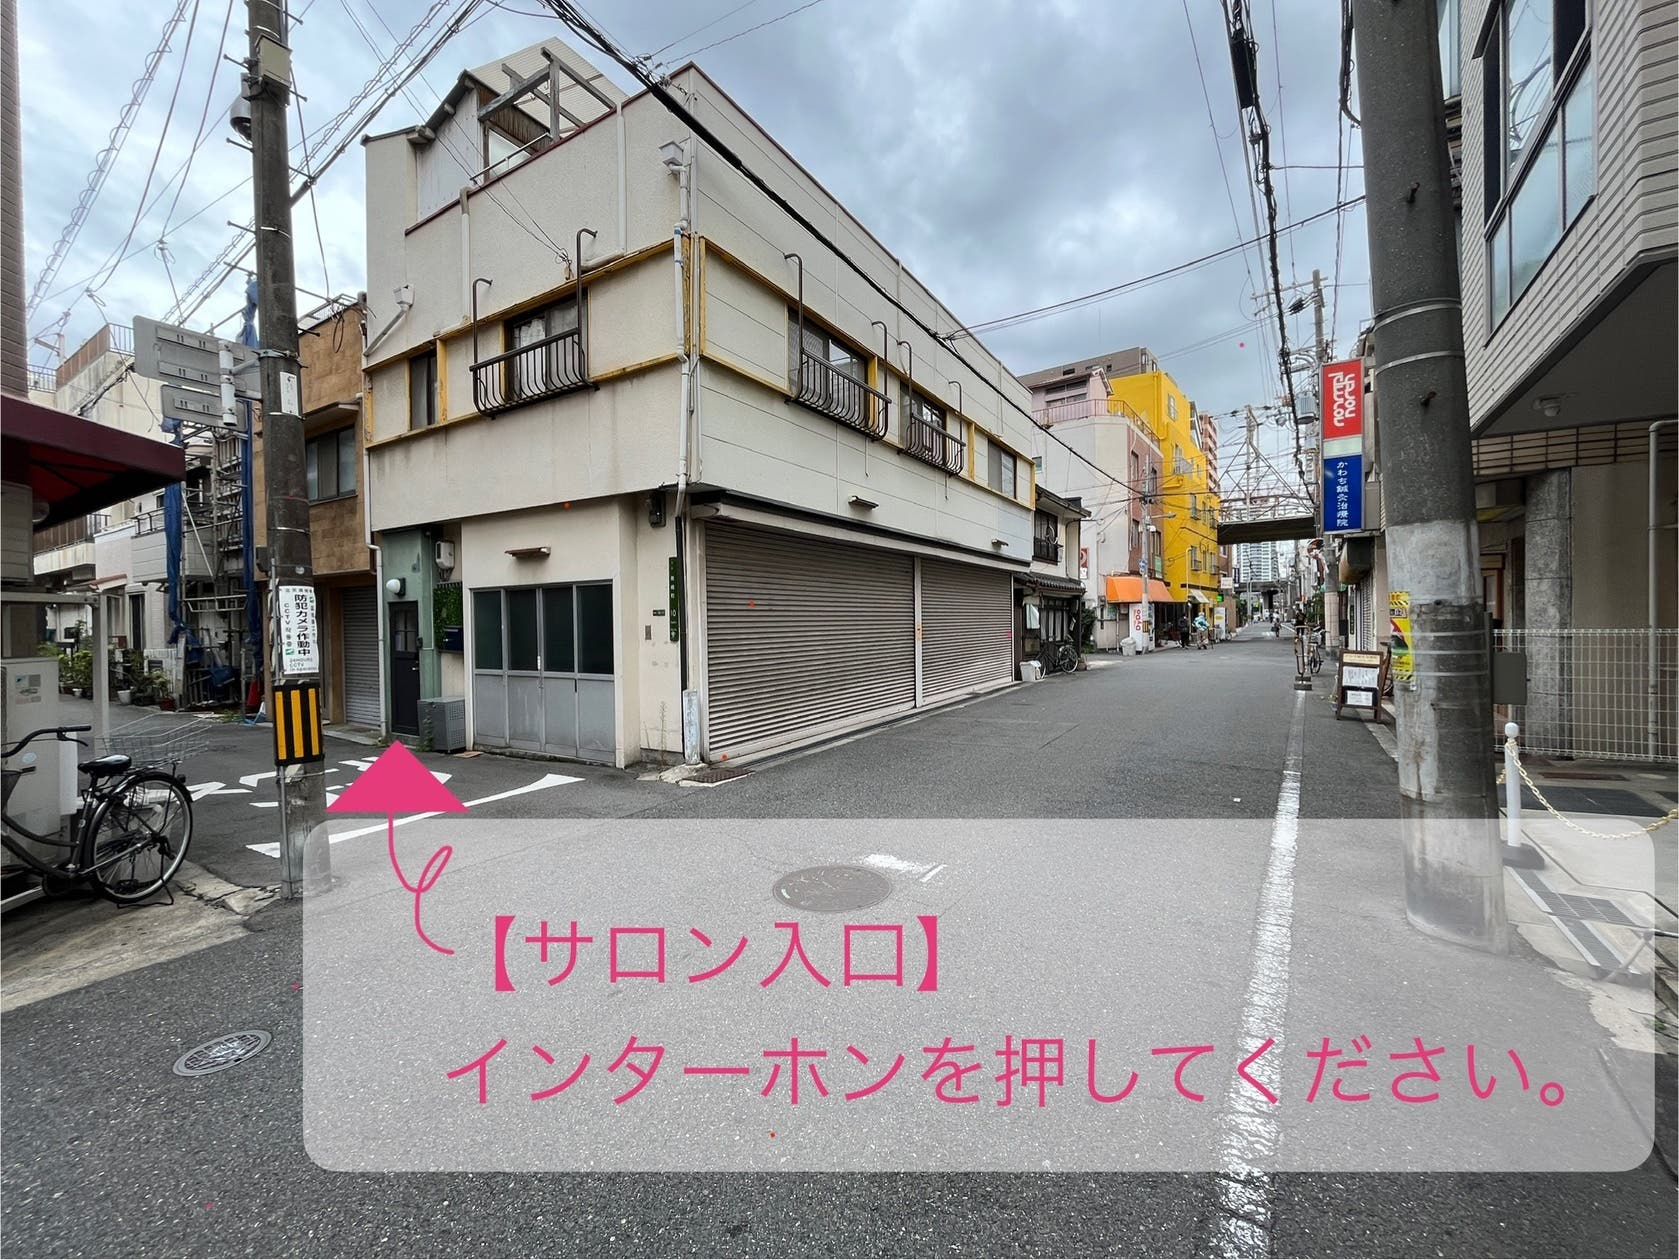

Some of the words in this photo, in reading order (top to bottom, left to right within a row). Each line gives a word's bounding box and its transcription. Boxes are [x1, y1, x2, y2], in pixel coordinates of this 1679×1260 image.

[1327, 371, 1345, 427] normal
[1341, 373, 1356, 418] north
[1336, 461, 1349, 527] かわち鍼灸治療院
[294, 593, 311, 656] 防犯カメラ作動中
